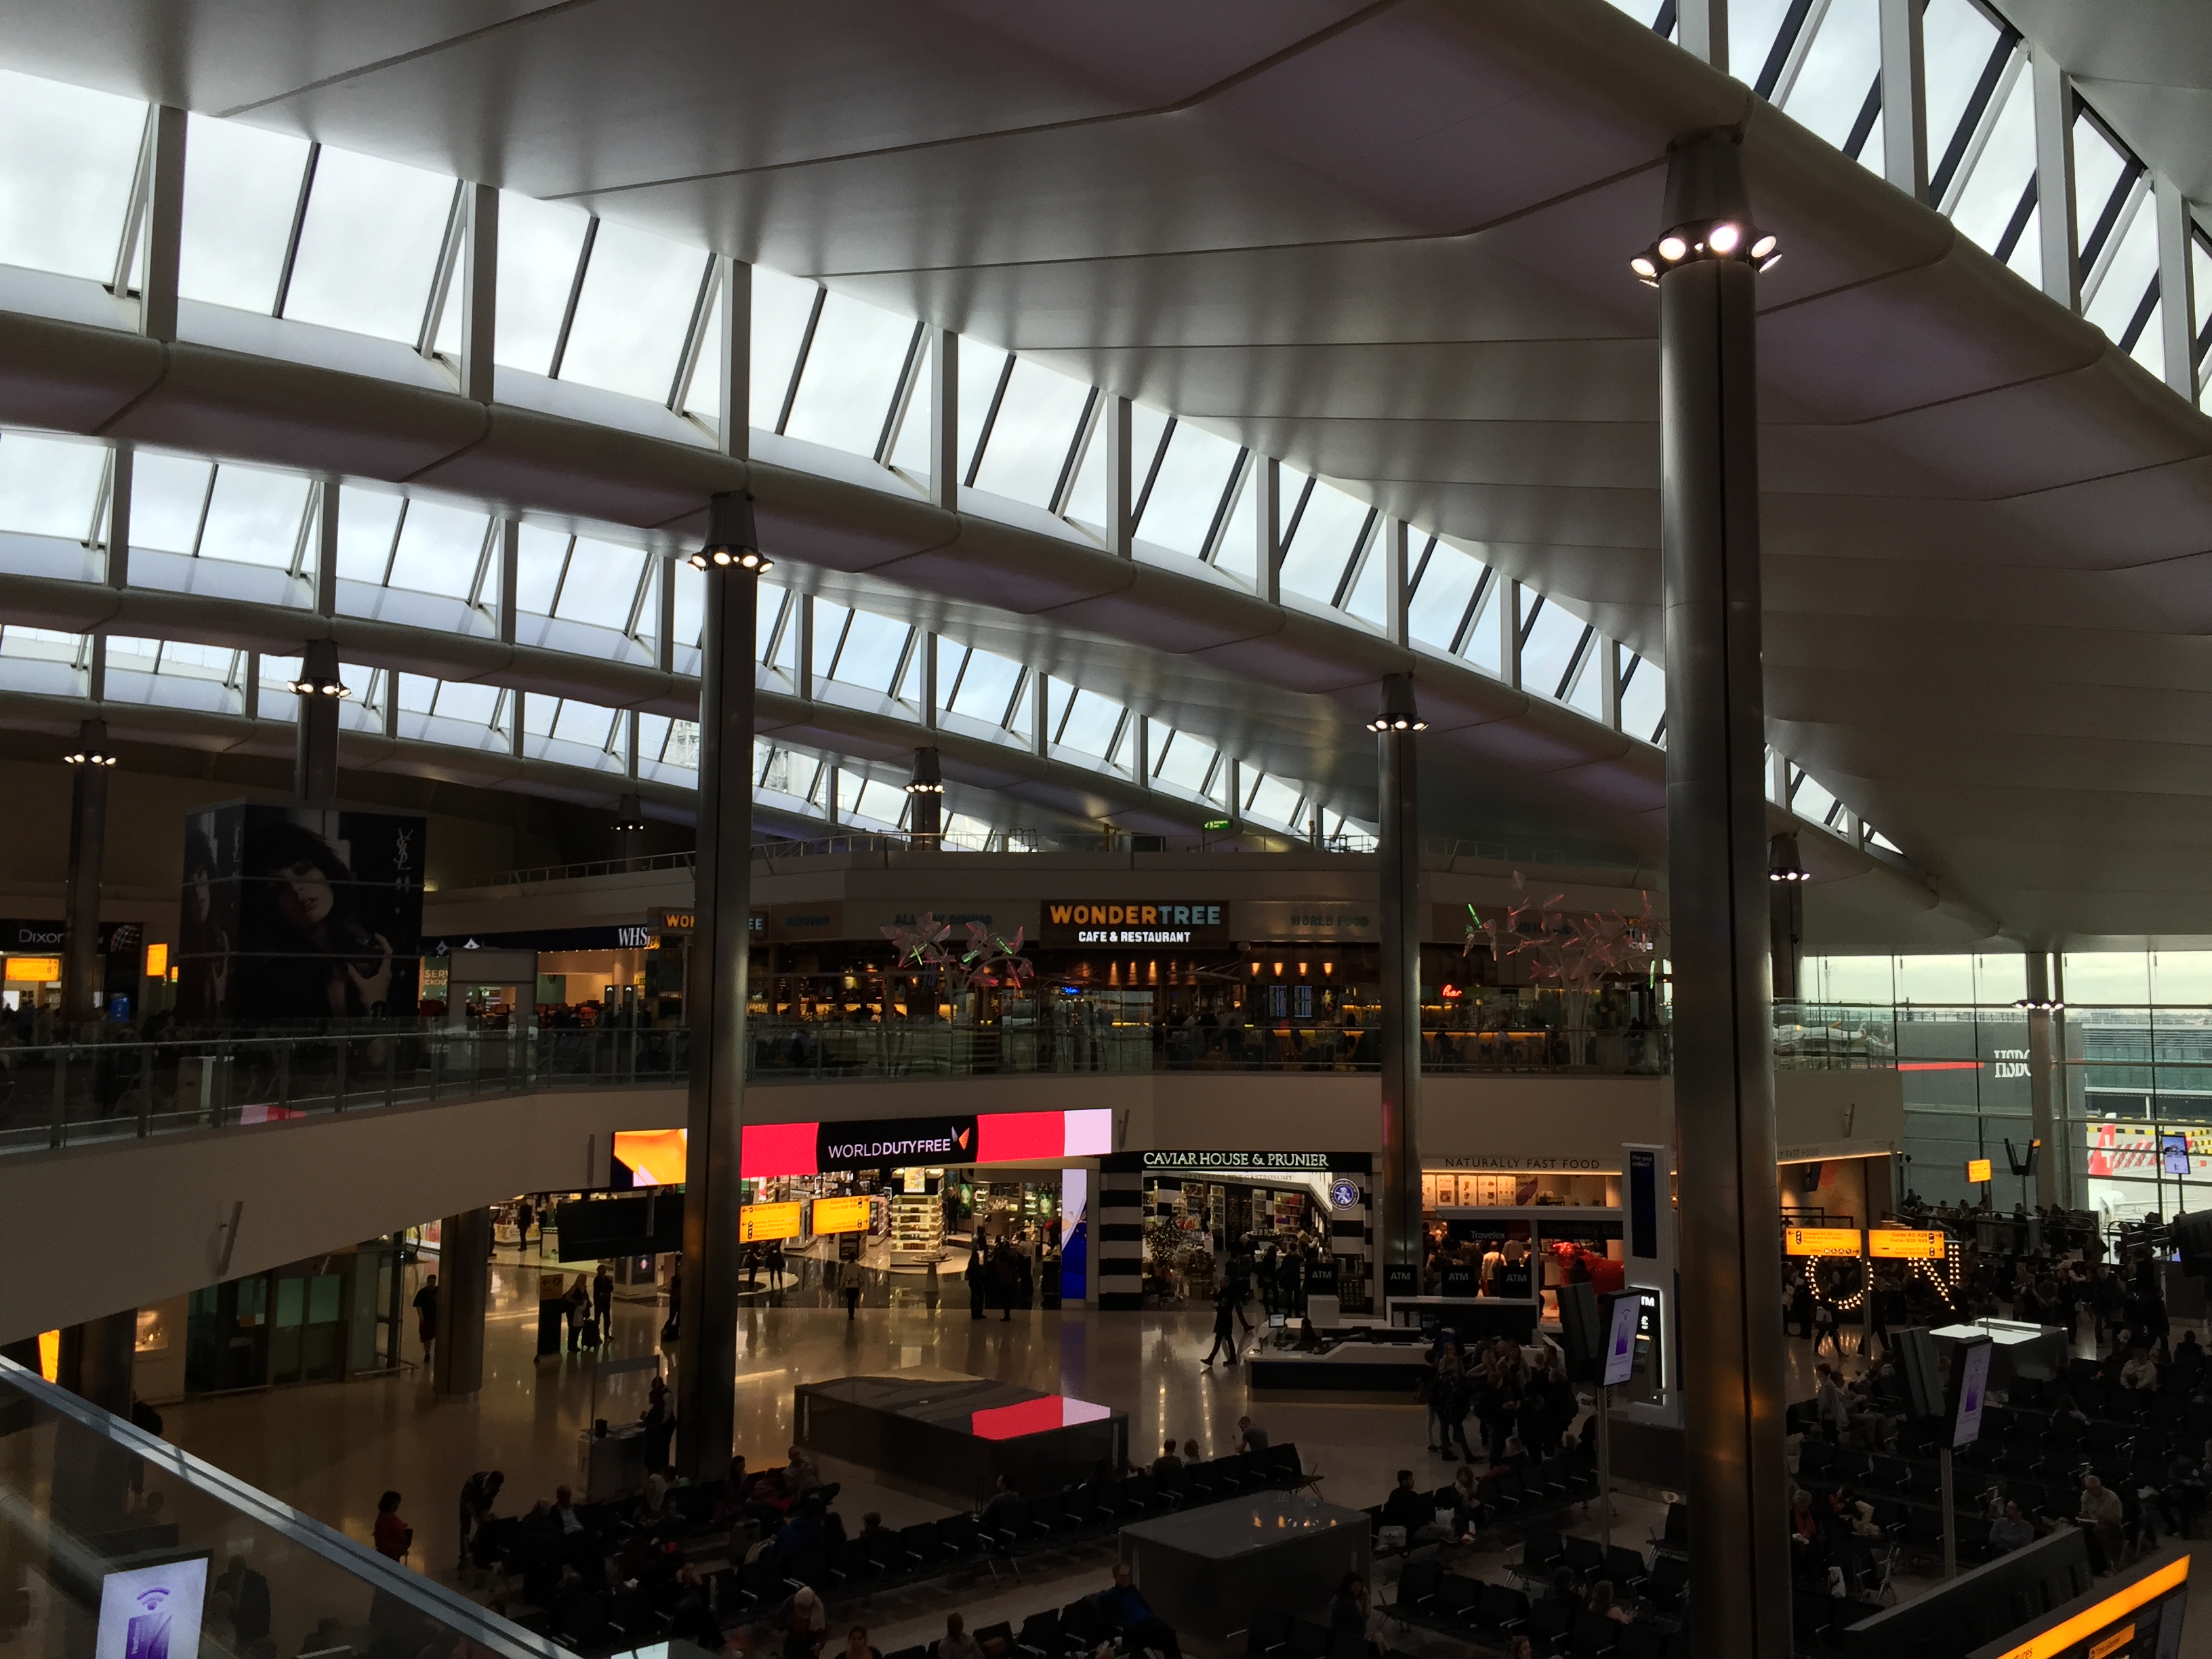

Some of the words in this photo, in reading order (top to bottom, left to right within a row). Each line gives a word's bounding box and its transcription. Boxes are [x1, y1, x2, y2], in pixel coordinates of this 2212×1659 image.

[1050, 905, 1220, 926] WONDERTREE
[1291, 916, 1334, 926] WORLD
[1337, 916, 1369, 927] FOOD
[1078, 932, 1107, 943] CAFE
[1109, 931, 1118, 943] &
[1120, 931, 1191, 943] RESTAURANT
[1441, 985, 1462, 998] Bar
[1143, 1152, 1197, 1166] CAVIAR
[1200, 1153, 1249, 1166] HOUSE
[1252, 1153, 1265, 1166] &
[1268, 1153, 1329, 1167] PRUNIER
[1445, 1158, 1520, 1168] NATURALLY
[1526, 1159, 1557, 1168] FAST
[1562, 1159, 1599, 1169] FOOD
[1471, 1231, 1506, 1240] Travelex
[1547, 1225, 1599, 1236] Currency
[1311, 1271, 1332, 1279] ATM
[1390, 1271, 1411, 1280] ATM
[1448, 1273, 1469, 1282] ATM
[1505, 1273, 1527, 1282] ATM
[1641, 1296, 1655, 1307] TM
